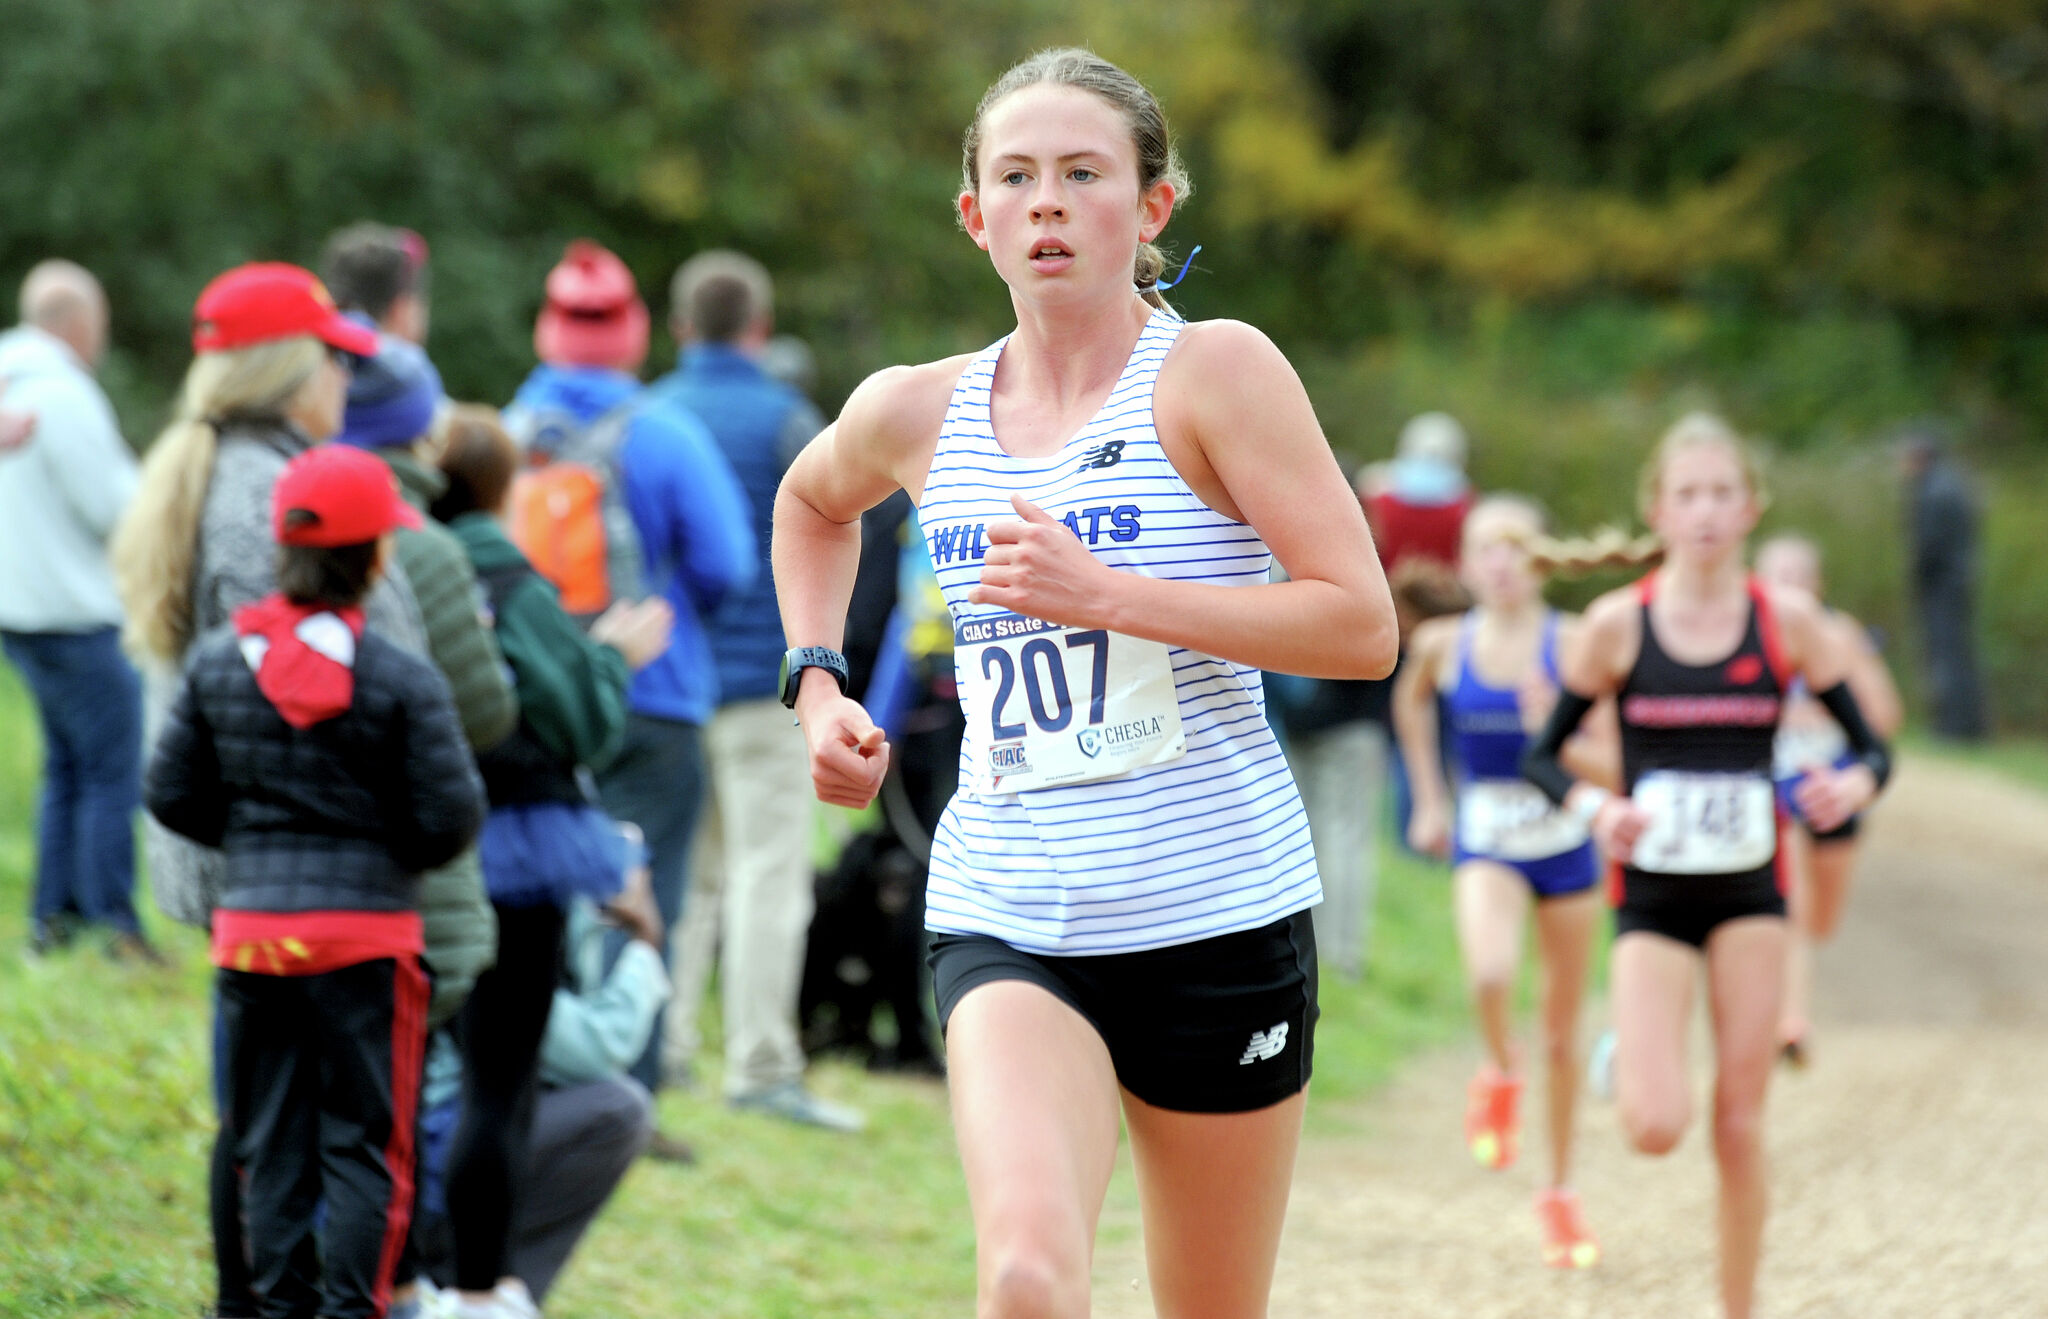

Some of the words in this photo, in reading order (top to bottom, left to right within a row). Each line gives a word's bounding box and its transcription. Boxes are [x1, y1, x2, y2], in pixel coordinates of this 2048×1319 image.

[934, 505, 1141, 565] WILATS
[962, 622, 993, 642] CIAC
[994, 617, 1043, 637] State
[981, 629, 1110, 742] 207
[992, 747, 1026, 767] CIAC
